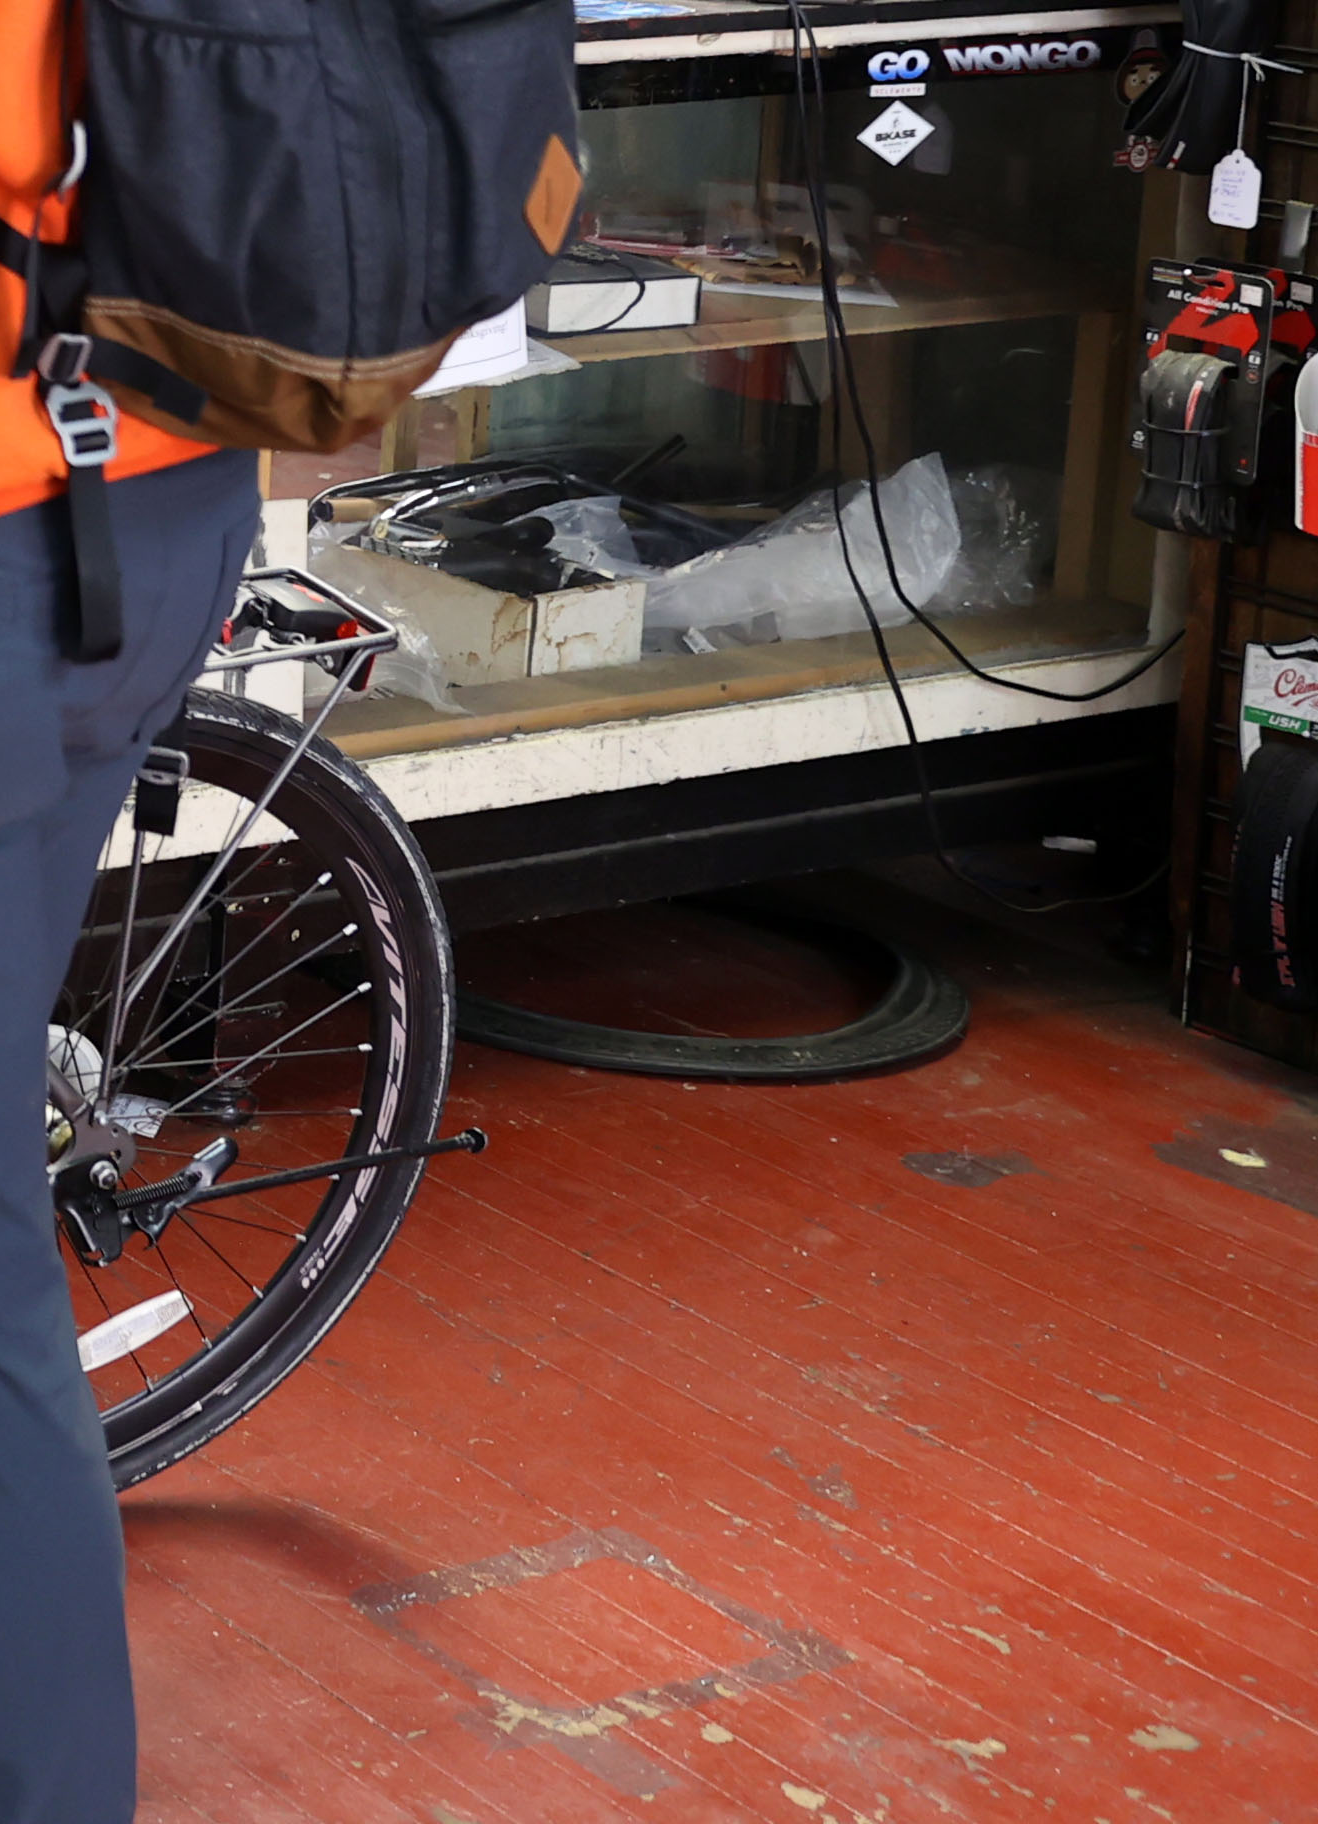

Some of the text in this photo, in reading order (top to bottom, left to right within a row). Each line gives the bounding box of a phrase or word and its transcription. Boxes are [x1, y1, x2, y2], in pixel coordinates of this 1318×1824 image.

[867, 39, 1103, 83] GO MONGO
[1166, 289, 1182, 302] All
[1183, 291, 1231, 311] Condition
[1231, 302, 1251, 315] Pro
[1268, 713, 1301, 731] USH
